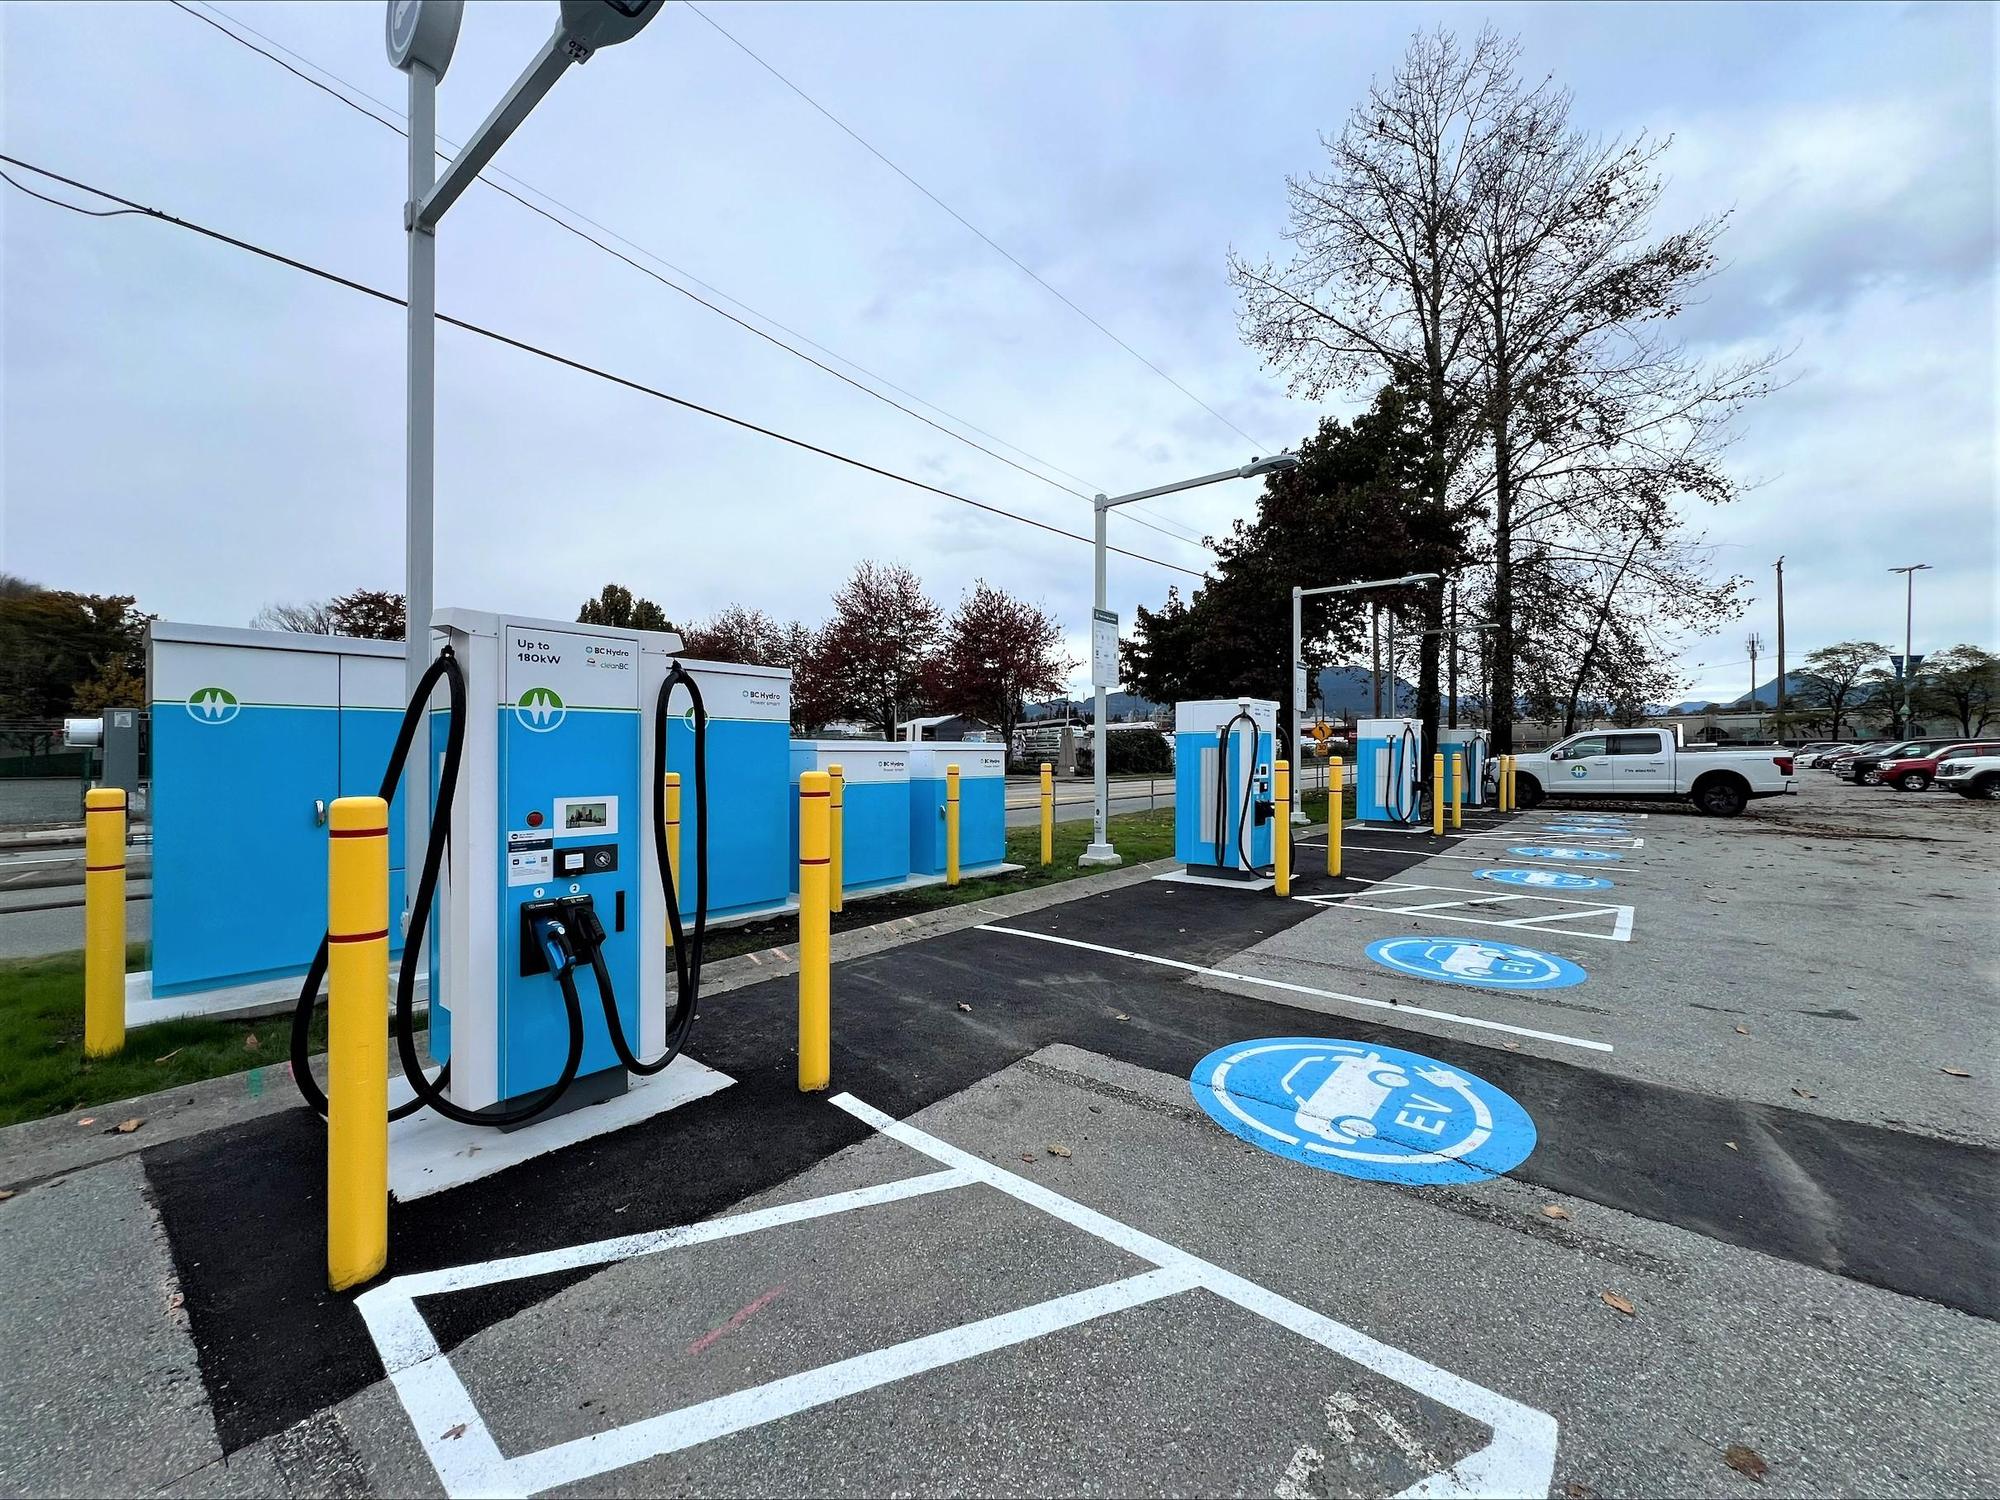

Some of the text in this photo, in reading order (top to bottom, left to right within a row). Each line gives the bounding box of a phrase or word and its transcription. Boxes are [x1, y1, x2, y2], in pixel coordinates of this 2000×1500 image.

[517, 639, 550, 651] Up to
[594, 647, 629, 657] BC Hydro
[517, 653, 561, 665] 180kW
[760, 692, 781, 700] Hydro
[1502, 959, 1536, 975] EV
[1394, 1093, 1453, 1136] EV
